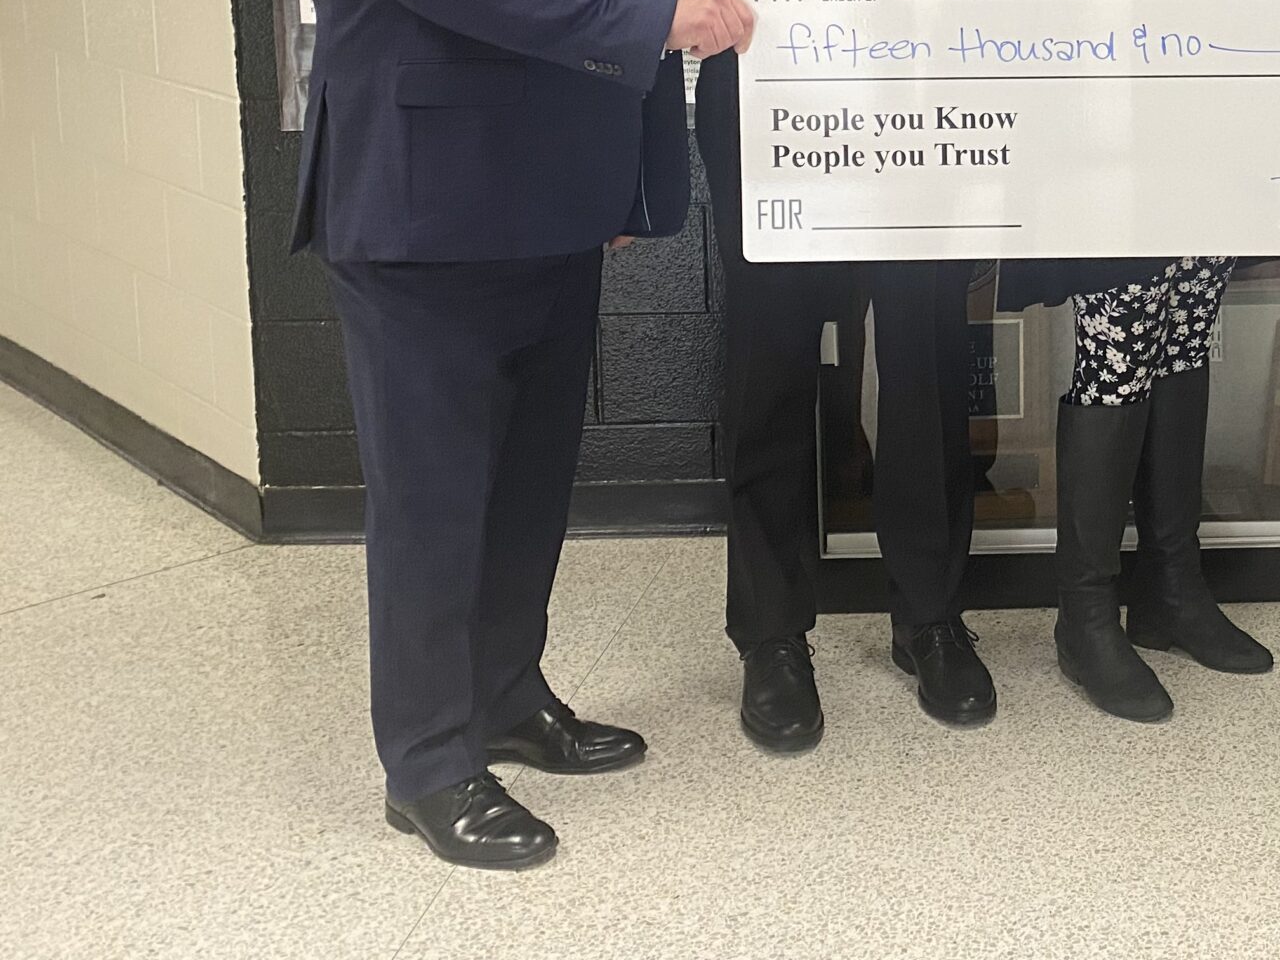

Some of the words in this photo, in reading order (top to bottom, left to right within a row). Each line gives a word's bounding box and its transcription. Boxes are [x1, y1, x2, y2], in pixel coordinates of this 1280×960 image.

[776, 22, 932, 69] fifteen
[947, 25, 1117, 64] thousand
[770, 107, 865, 138] People
[873, 111, 925, 137] you
[934, 106, 1019, 132] Know
[771, 144, 866, 175] People
[874, 148, 925, 174] you
[934, 142, 1012, 167] Trust
[757, 198, 803, 231] FOR
